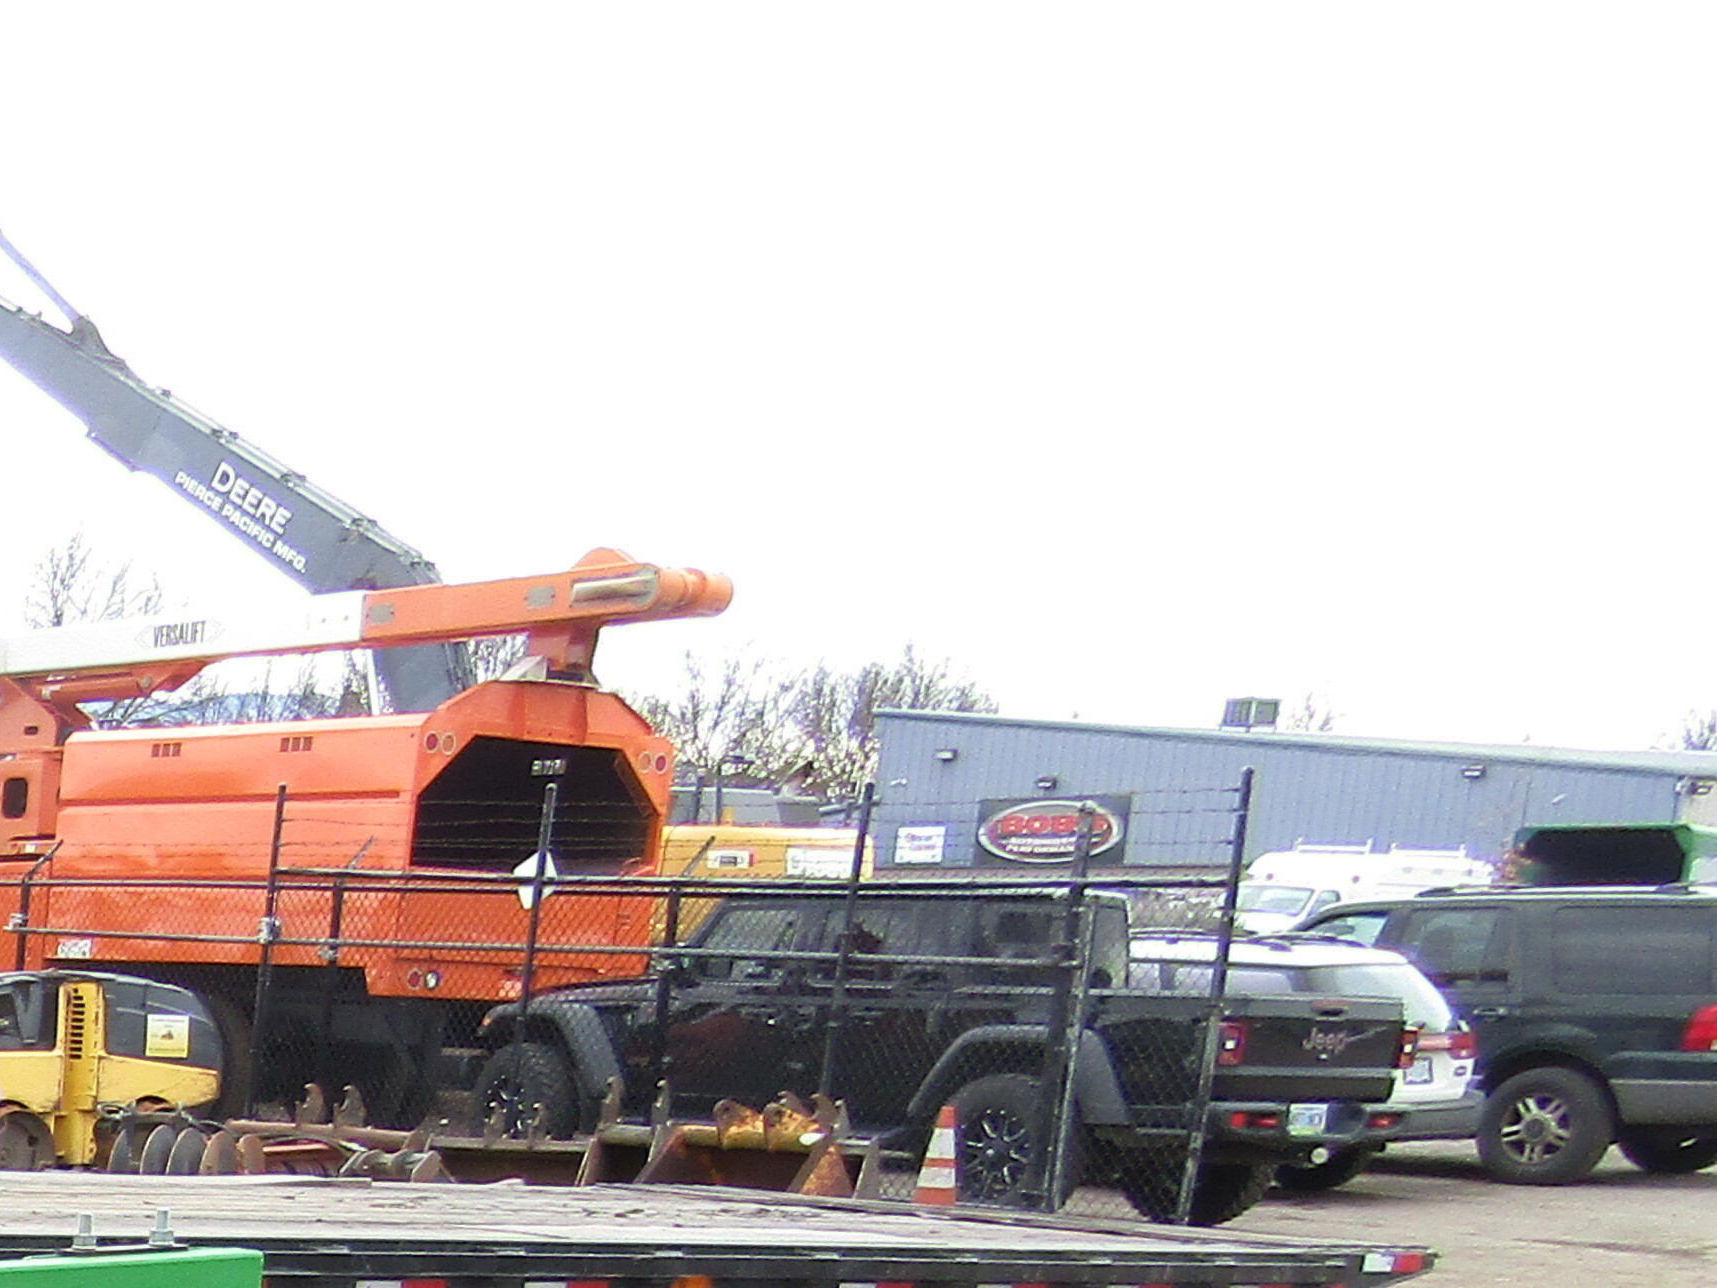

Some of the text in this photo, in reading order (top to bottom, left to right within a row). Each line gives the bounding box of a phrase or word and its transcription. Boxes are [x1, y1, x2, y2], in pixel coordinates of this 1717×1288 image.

[174, 471, 223, 511] PIERCE
[221, 503, 274, 548] PACIFIC
[210, 461, 293, 536] DEERE
[153, 620, 207, 649] VERSALIFT
[1302, 1027, 1346, 1055] Jeep
